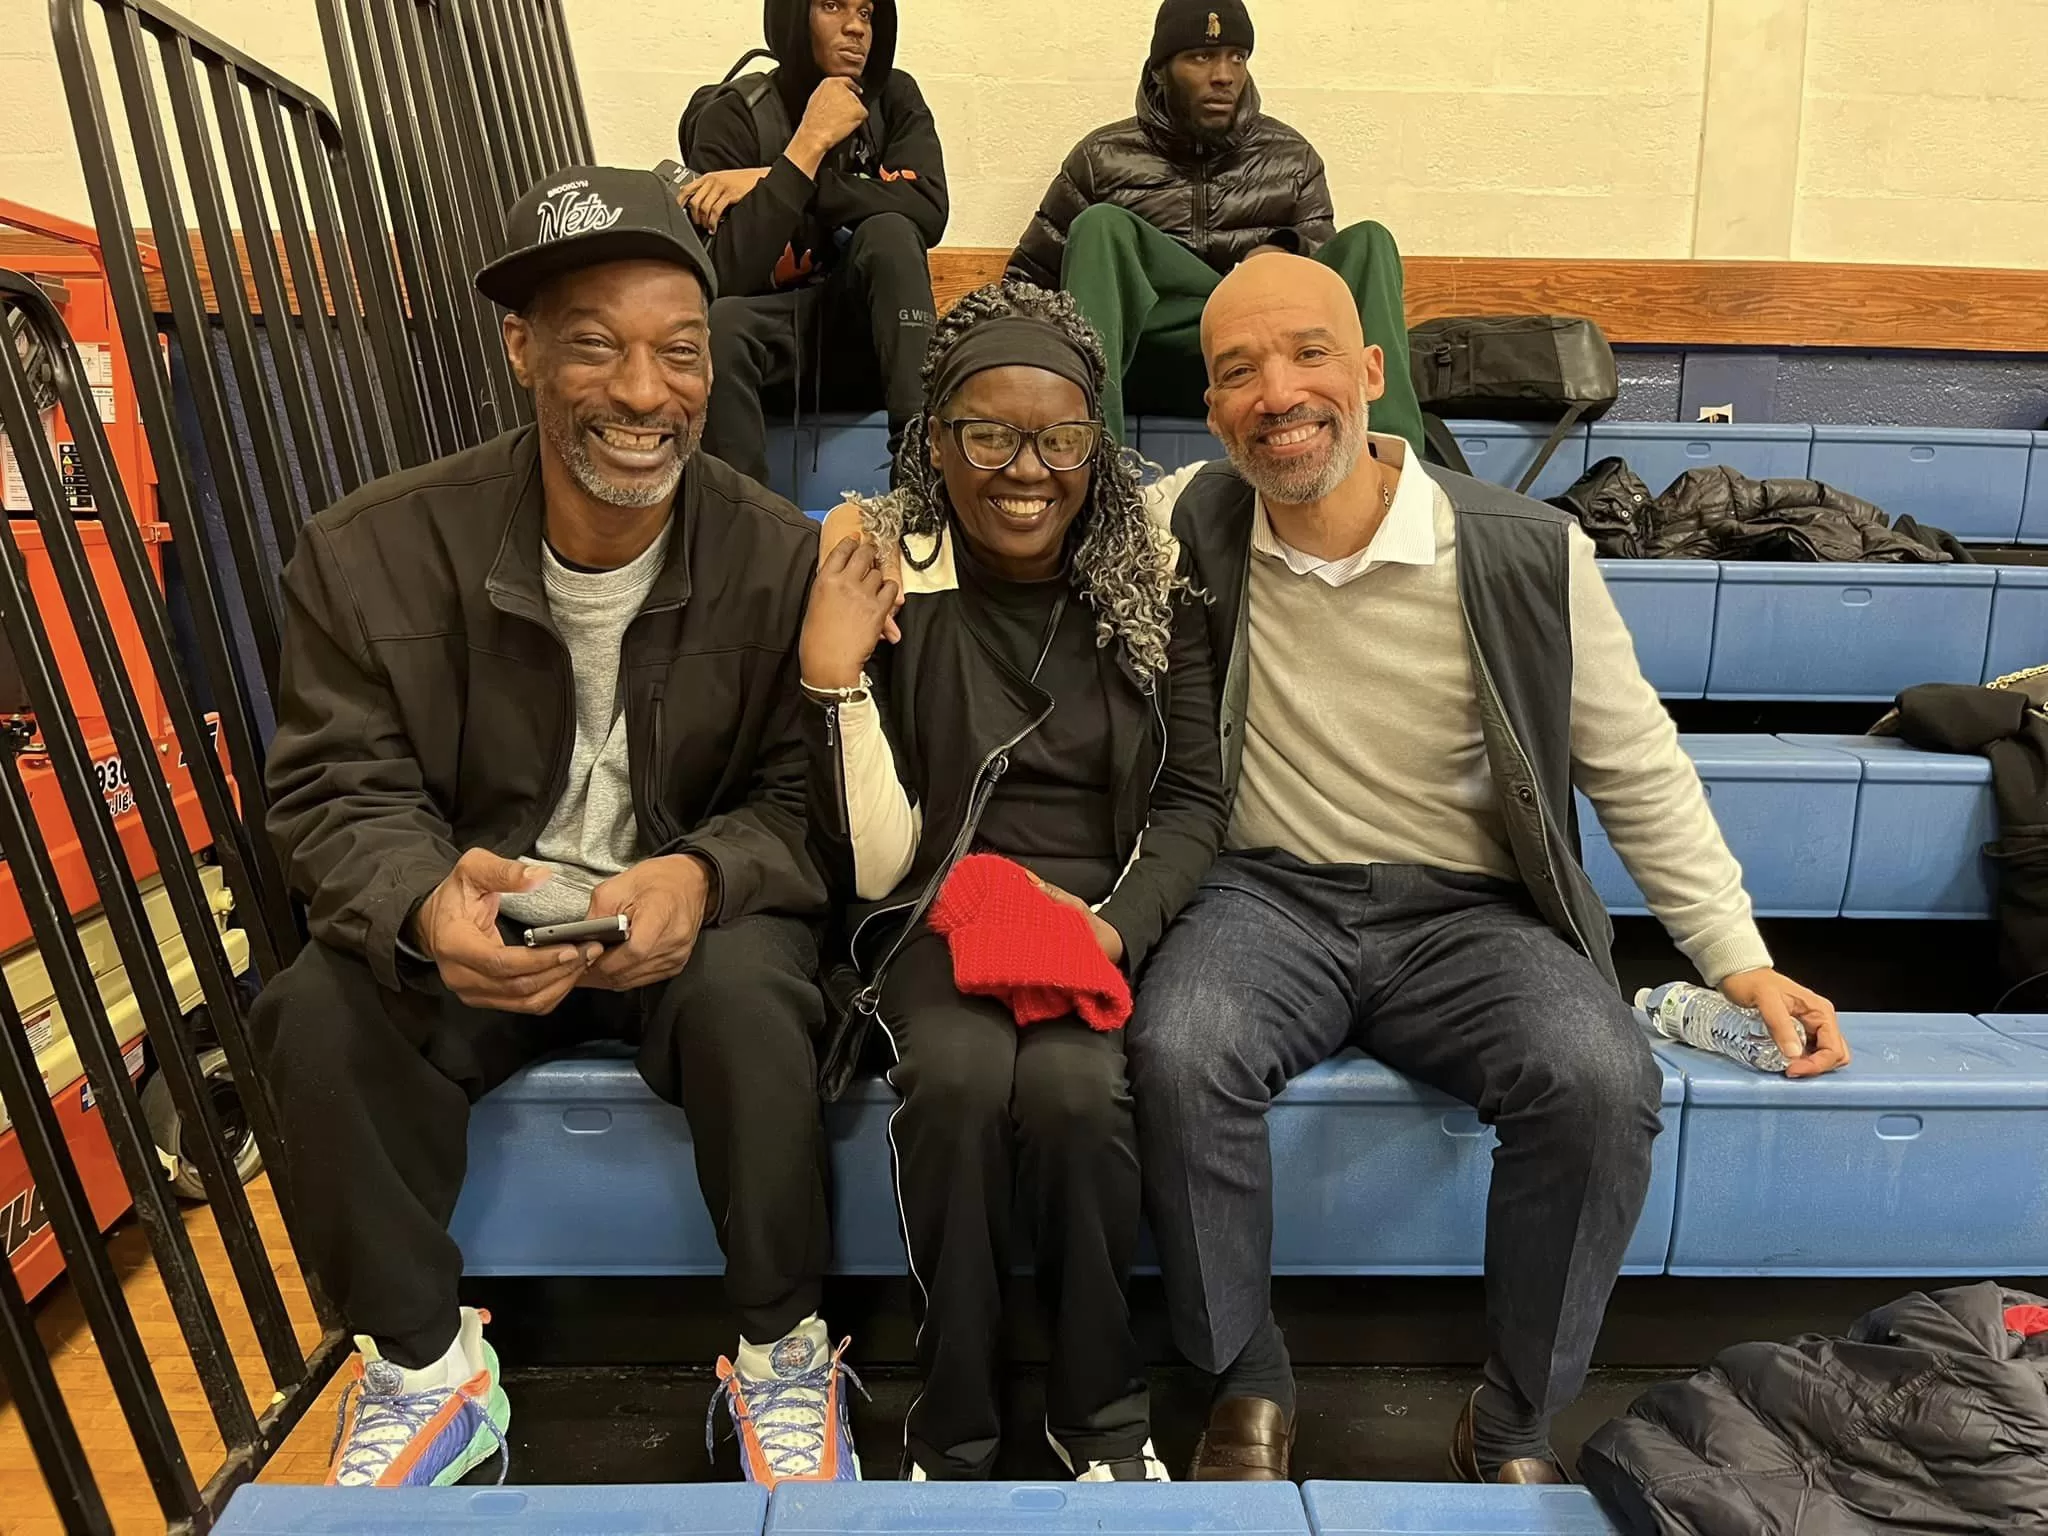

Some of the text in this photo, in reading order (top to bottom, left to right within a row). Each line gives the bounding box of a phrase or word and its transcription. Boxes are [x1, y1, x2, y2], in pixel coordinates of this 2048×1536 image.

[547, 180, 589, 198] BROOKLYN
[537, 191, 623, 245] Nets
[898, 308, 909, 320] G
